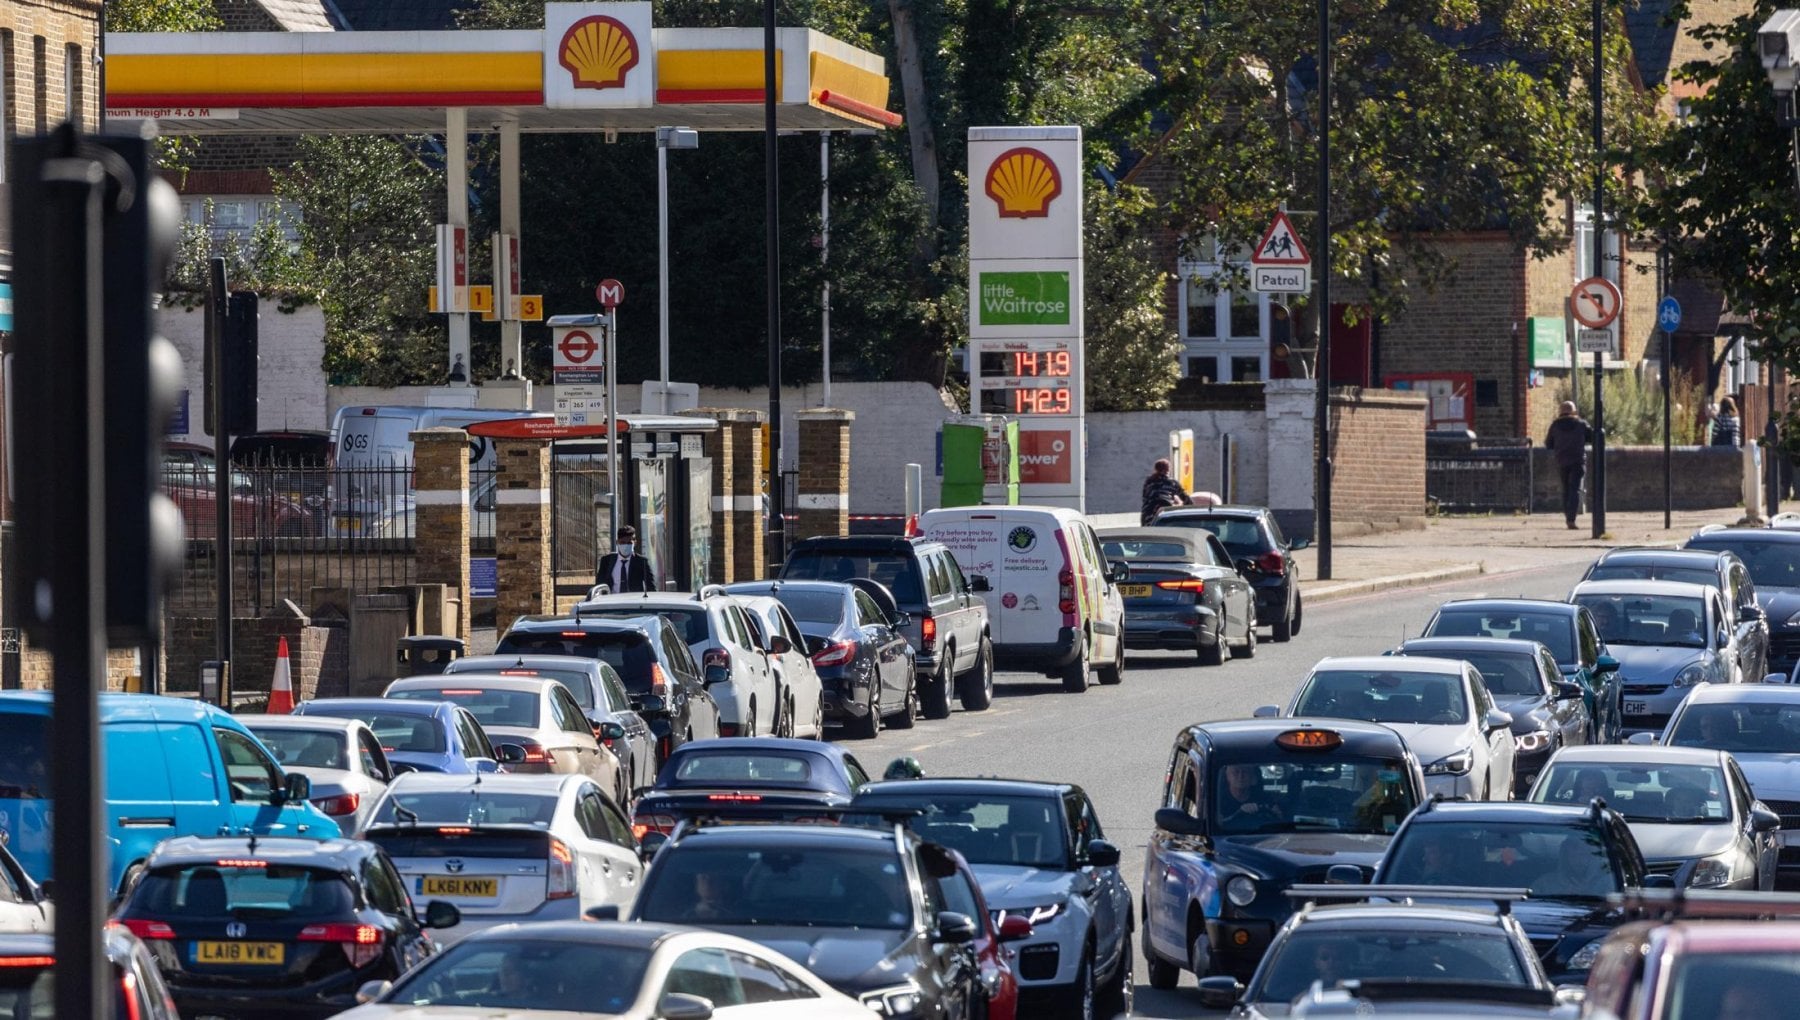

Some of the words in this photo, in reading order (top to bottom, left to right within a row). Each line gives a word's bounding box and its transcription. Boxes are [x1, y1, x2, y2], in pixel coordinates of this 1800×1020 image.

[136, 108, 171, 118] Height
[175, 108, 195, 117] 4.6
[199, 108, 210, 117] M
[1262, 275, 1299, 286] Patrol
[600, 286, 620, 304] M
[983, 283, 1015, 297] little
[475, 292, 482, 306] 1
[984, 297, 1065, 313] Waitrose
[525, 301, 536, 315] 3
[1015, 351, 1070, 376] 141.9
[1015, 388, 1070, 413] 142.9
[354, 434, 368, 449] GS
[1129, 586, 1146, 594] BHP
[1625, 703, 1647, 713] CHF
[1295, 732, 1329, 745] TAXI
[428, 880, 460, 893] LK61
[463, 881, 492, 894] KNY
[203, 943, 240, 959] LA18
